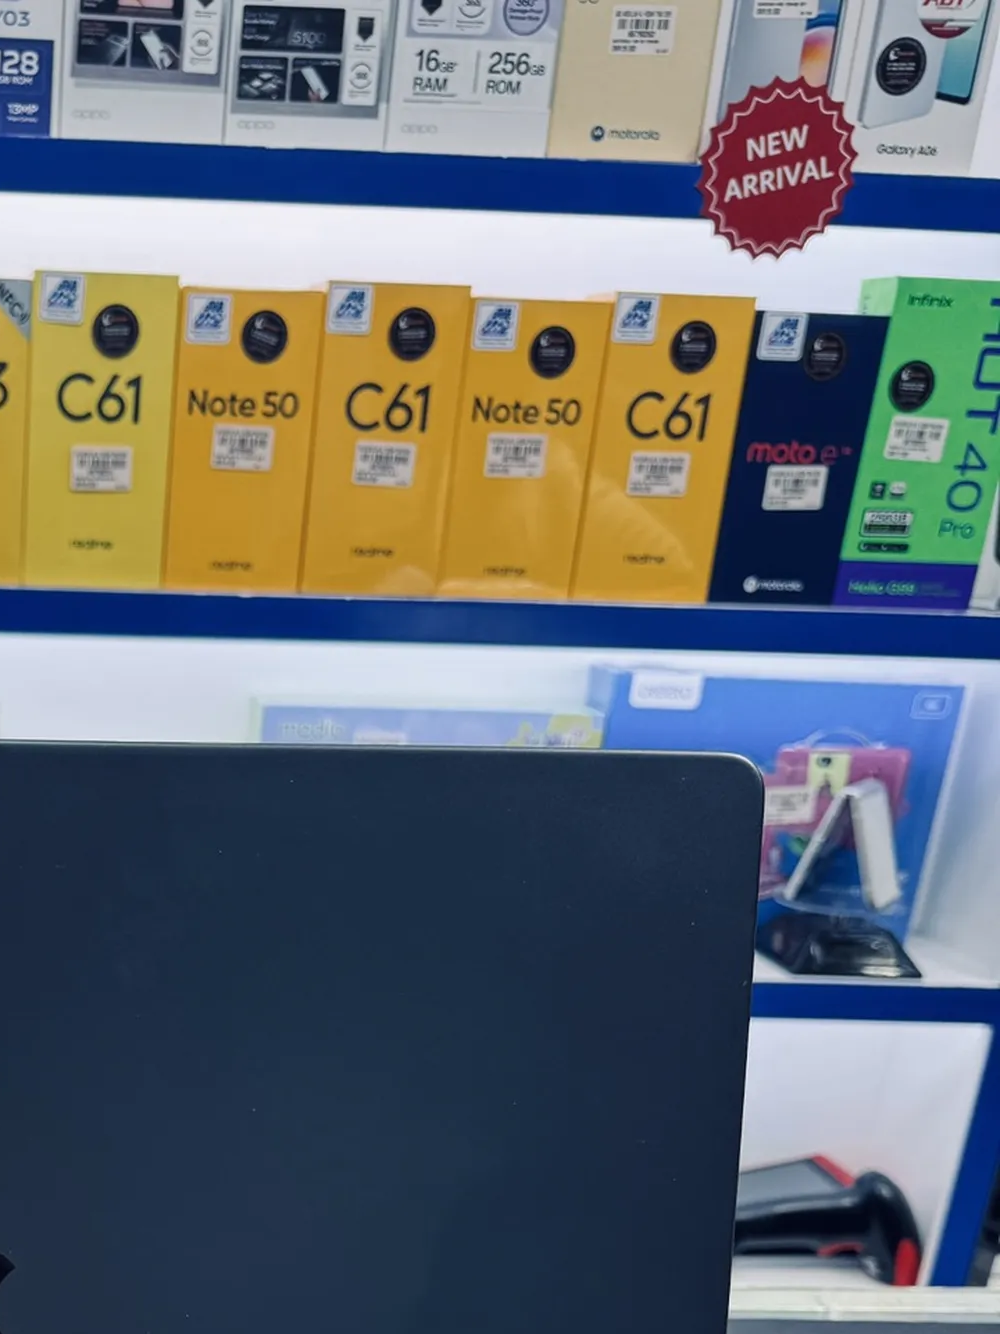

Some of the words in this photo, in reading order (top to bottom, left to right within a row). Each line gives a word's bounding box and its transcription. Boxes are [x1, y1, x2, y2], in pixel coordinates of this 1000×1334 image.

[412, 77, 449, 93] RAM
[485, 80, 522, 95] ROM
[608, 127, 661, 142] motorola
[745, 123, 810, 162] NEW
[876, 142, 917, 159] Galaxy
[723, 156, 835, 204] ARRIVAL
[56, 371, 143, 426] C61
[186, 388, 257, 419] Note
[262, 391, 300, 420] 50
[344, 381, 433, 434] C61
[471, 396, 540, 426] Note
[545, 397, 582, 426] 50
[625, 390, 713, 442] C61
[745, 441, 817, 466] moto
[946, 440, 989, 513] 40
[937, 517, 977, 541] Pro
